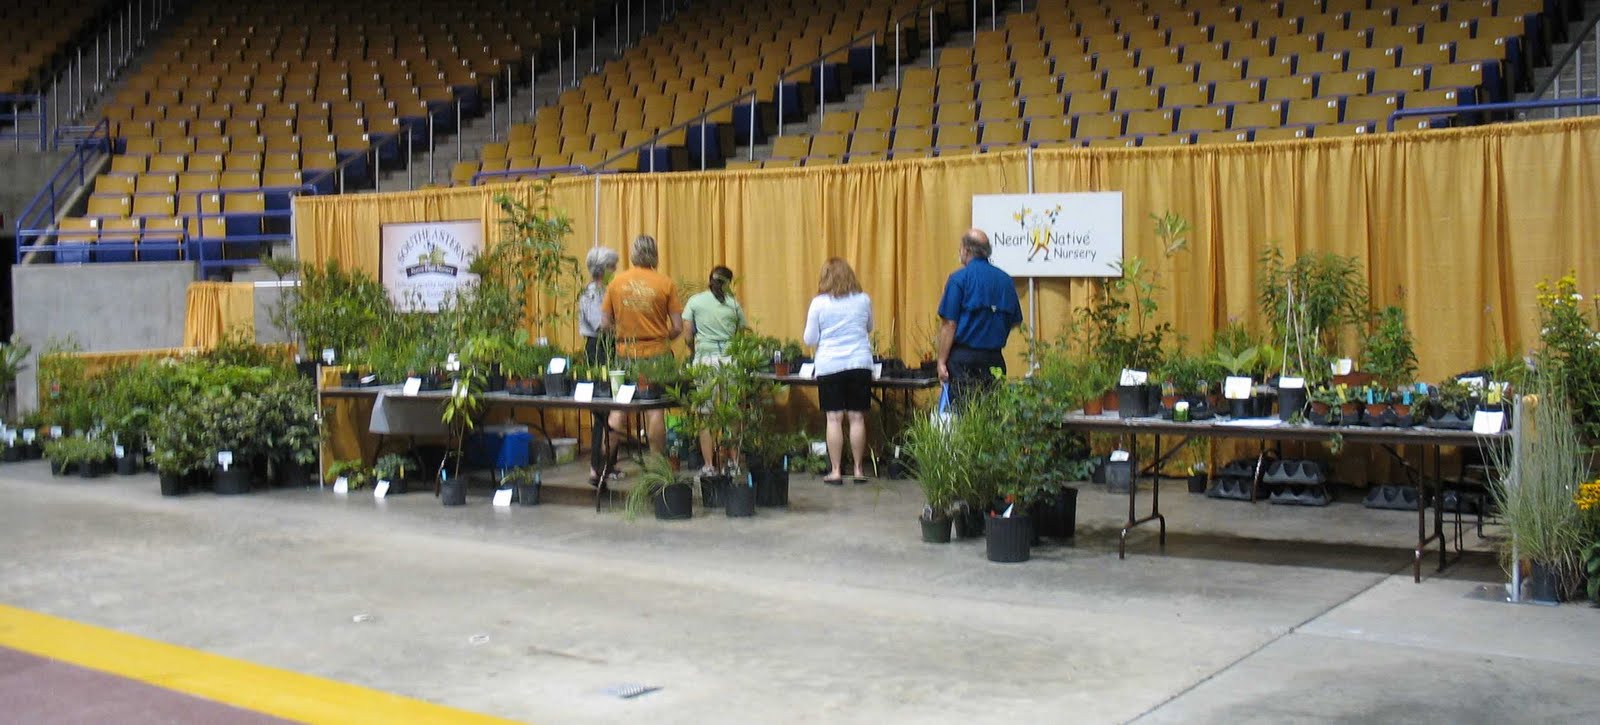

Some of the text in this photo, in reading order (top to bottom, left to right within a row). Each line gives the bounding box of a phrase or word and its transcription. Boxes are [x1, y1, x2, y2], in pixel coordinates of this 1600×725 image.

[994, 231, 1090, 253] Nearly Native
[1053, 247, 1097, 262] Nursery
